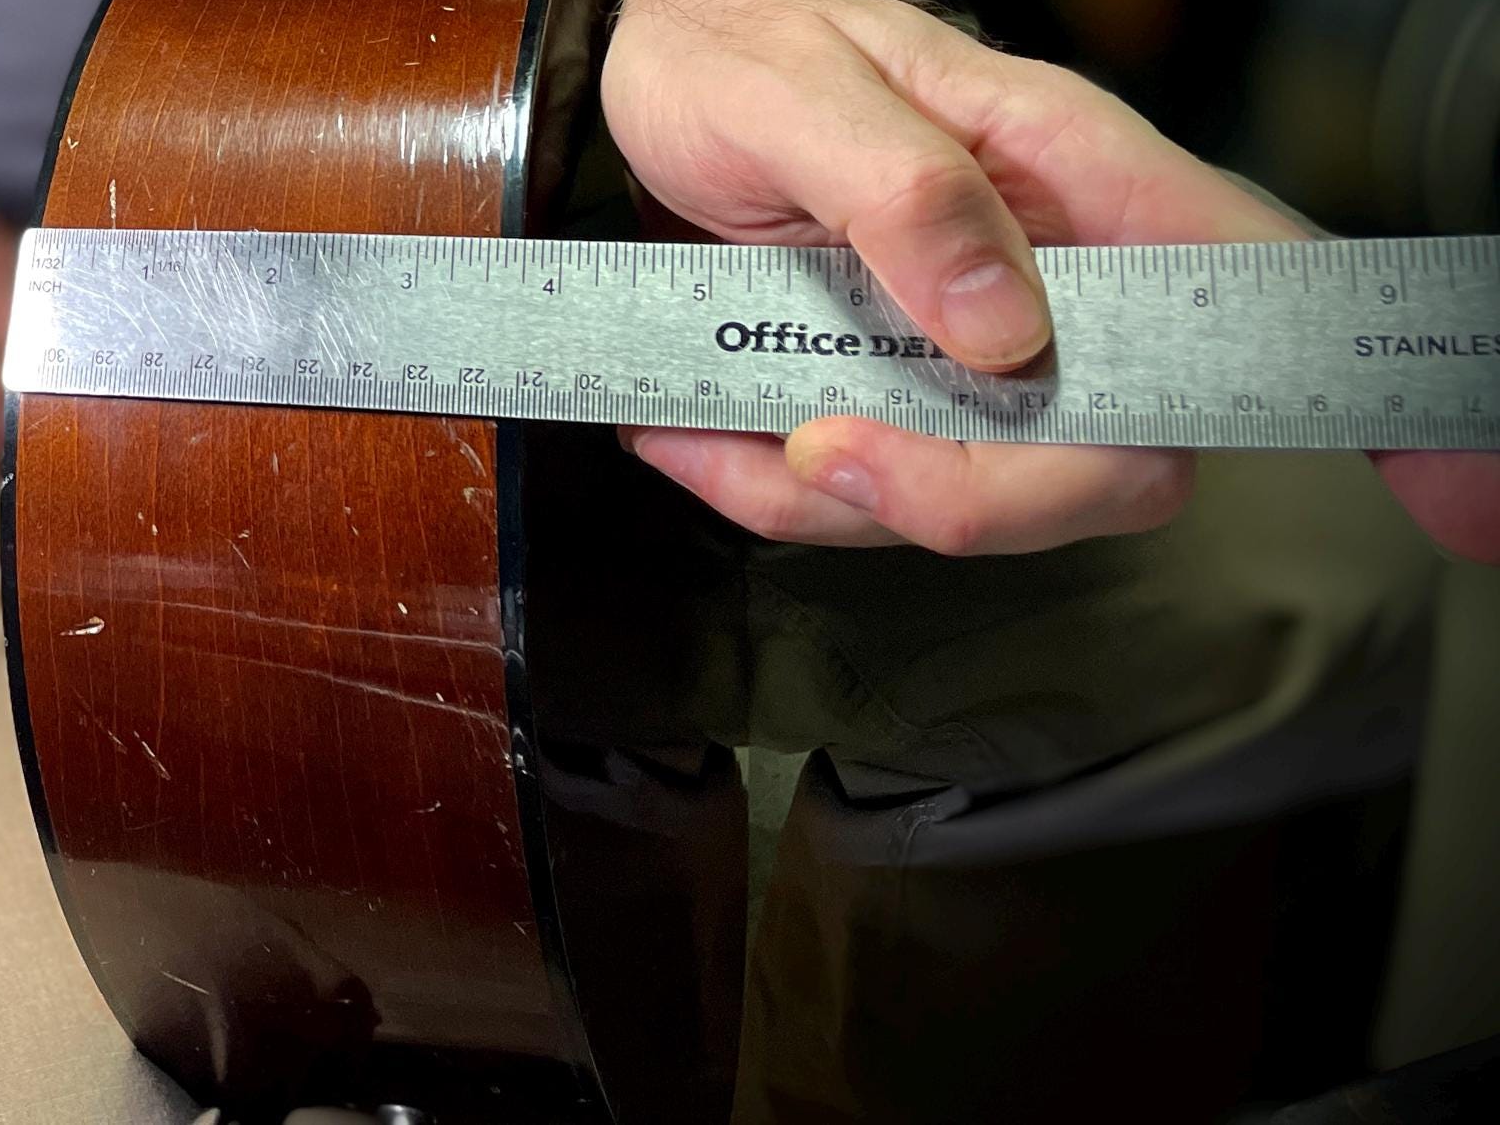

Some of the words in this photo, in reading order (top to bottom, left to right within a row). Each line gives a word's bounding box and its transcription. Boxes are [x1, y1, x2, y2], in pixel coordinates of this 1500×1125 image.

[28, 280, 62, 293] INCH
[35, 257, 61, 269] 1/32
[141, 266, 150, 281] 1
[156, 260, 181, 273] 1/16
[265, 267, 277, 285] 2
[401, 272, 412, 289] 3
[542, 278, 555, 295] 4
[693, 283, 706, 301] 5
[850, 287, 863, 306] 6
[1193, 287, 1209, 307] 8
[1379, 284, 1396, 305] 9
[715, 321, 862, 356] Office
[95, 350, 114, 365] 29
[144, 351, 163, 366] 28
[194, 354, 213, 369] 27
[298, 359, 319, 374] 25
[353, 362, 373, 377] 24
[406, 364, 428, 380] 23
[463, 367, 485, 383] 22
[521, 371, 543, 387] 21
[579, 374, 601, 390] 20
[639, 377, 660, 393] 19
[700, 380, 721, 396] 18
[762, 383, 784, 399] 17
[826, 386, 849, 402] 16
[891, 388, 914, 404] 15
[958, 393, 980, 408] 14
[1025, 392, 1049, 408] 13
[1094, 392, 1119, 410] 12
[1167, 393, 1190, 410] 11
[1239, 394, 1265, 411] 10
[1313, 395, 1327, 412] 9
[1389, 394, 1404, 412] 8
